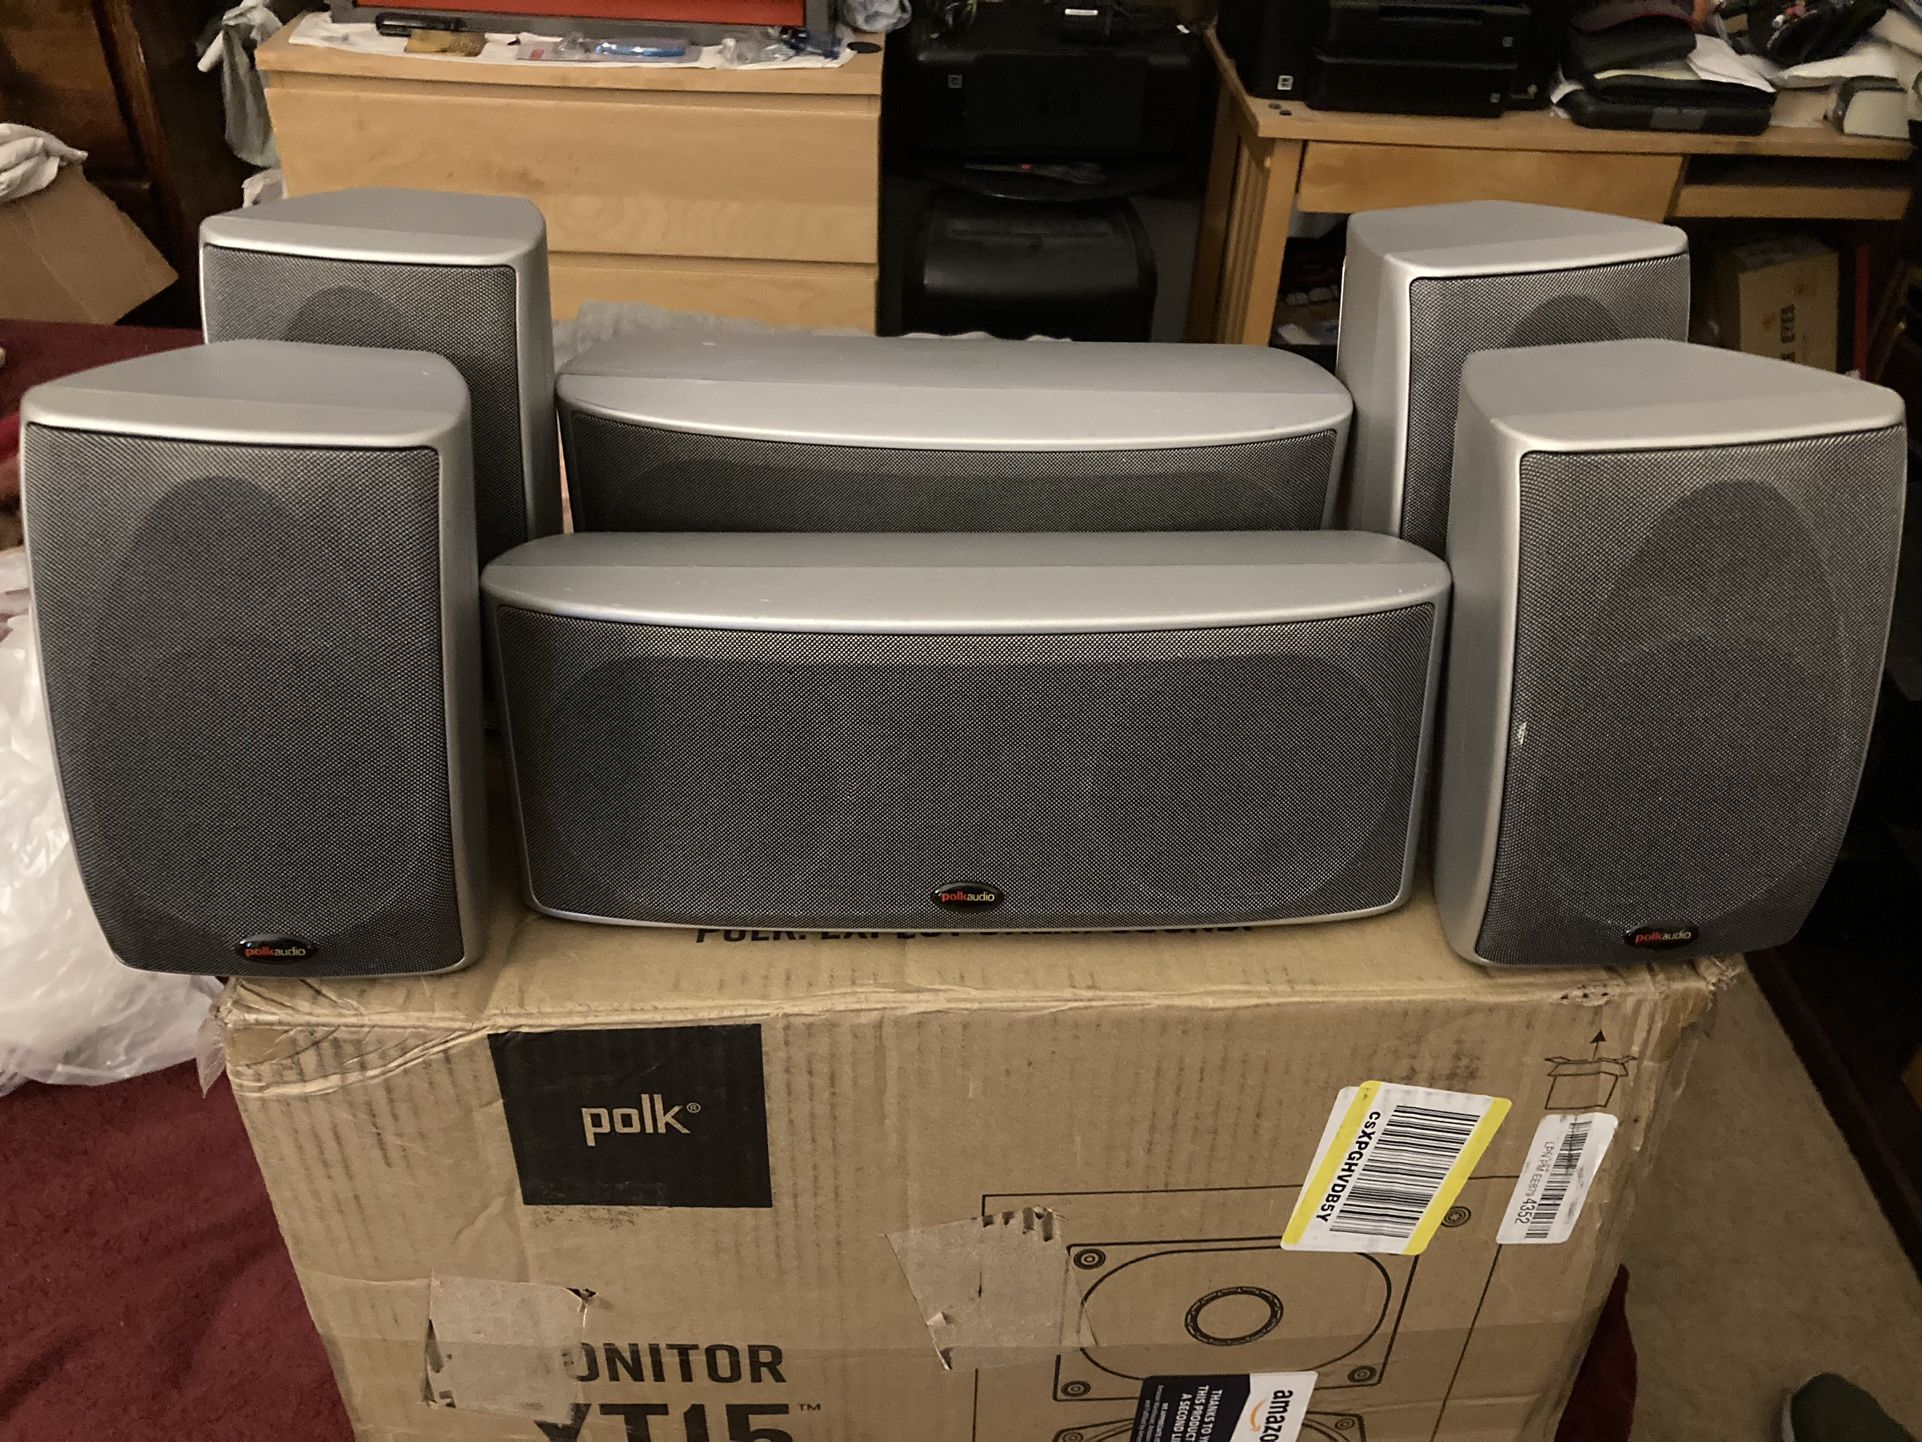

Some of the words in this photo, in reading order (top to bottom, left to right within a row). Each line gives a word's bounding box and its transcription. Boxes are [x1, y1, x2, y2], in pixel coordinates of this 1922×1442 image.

[940, 891, 995, 902] polkaudio
[1194, 1385, 1210, 1405] THIS
[1204, 1389, 1223, 1423] THANKS
[1173, 1400, 1191, 1433] SECOND
[1201, 1422, 1213, 1435] TO
